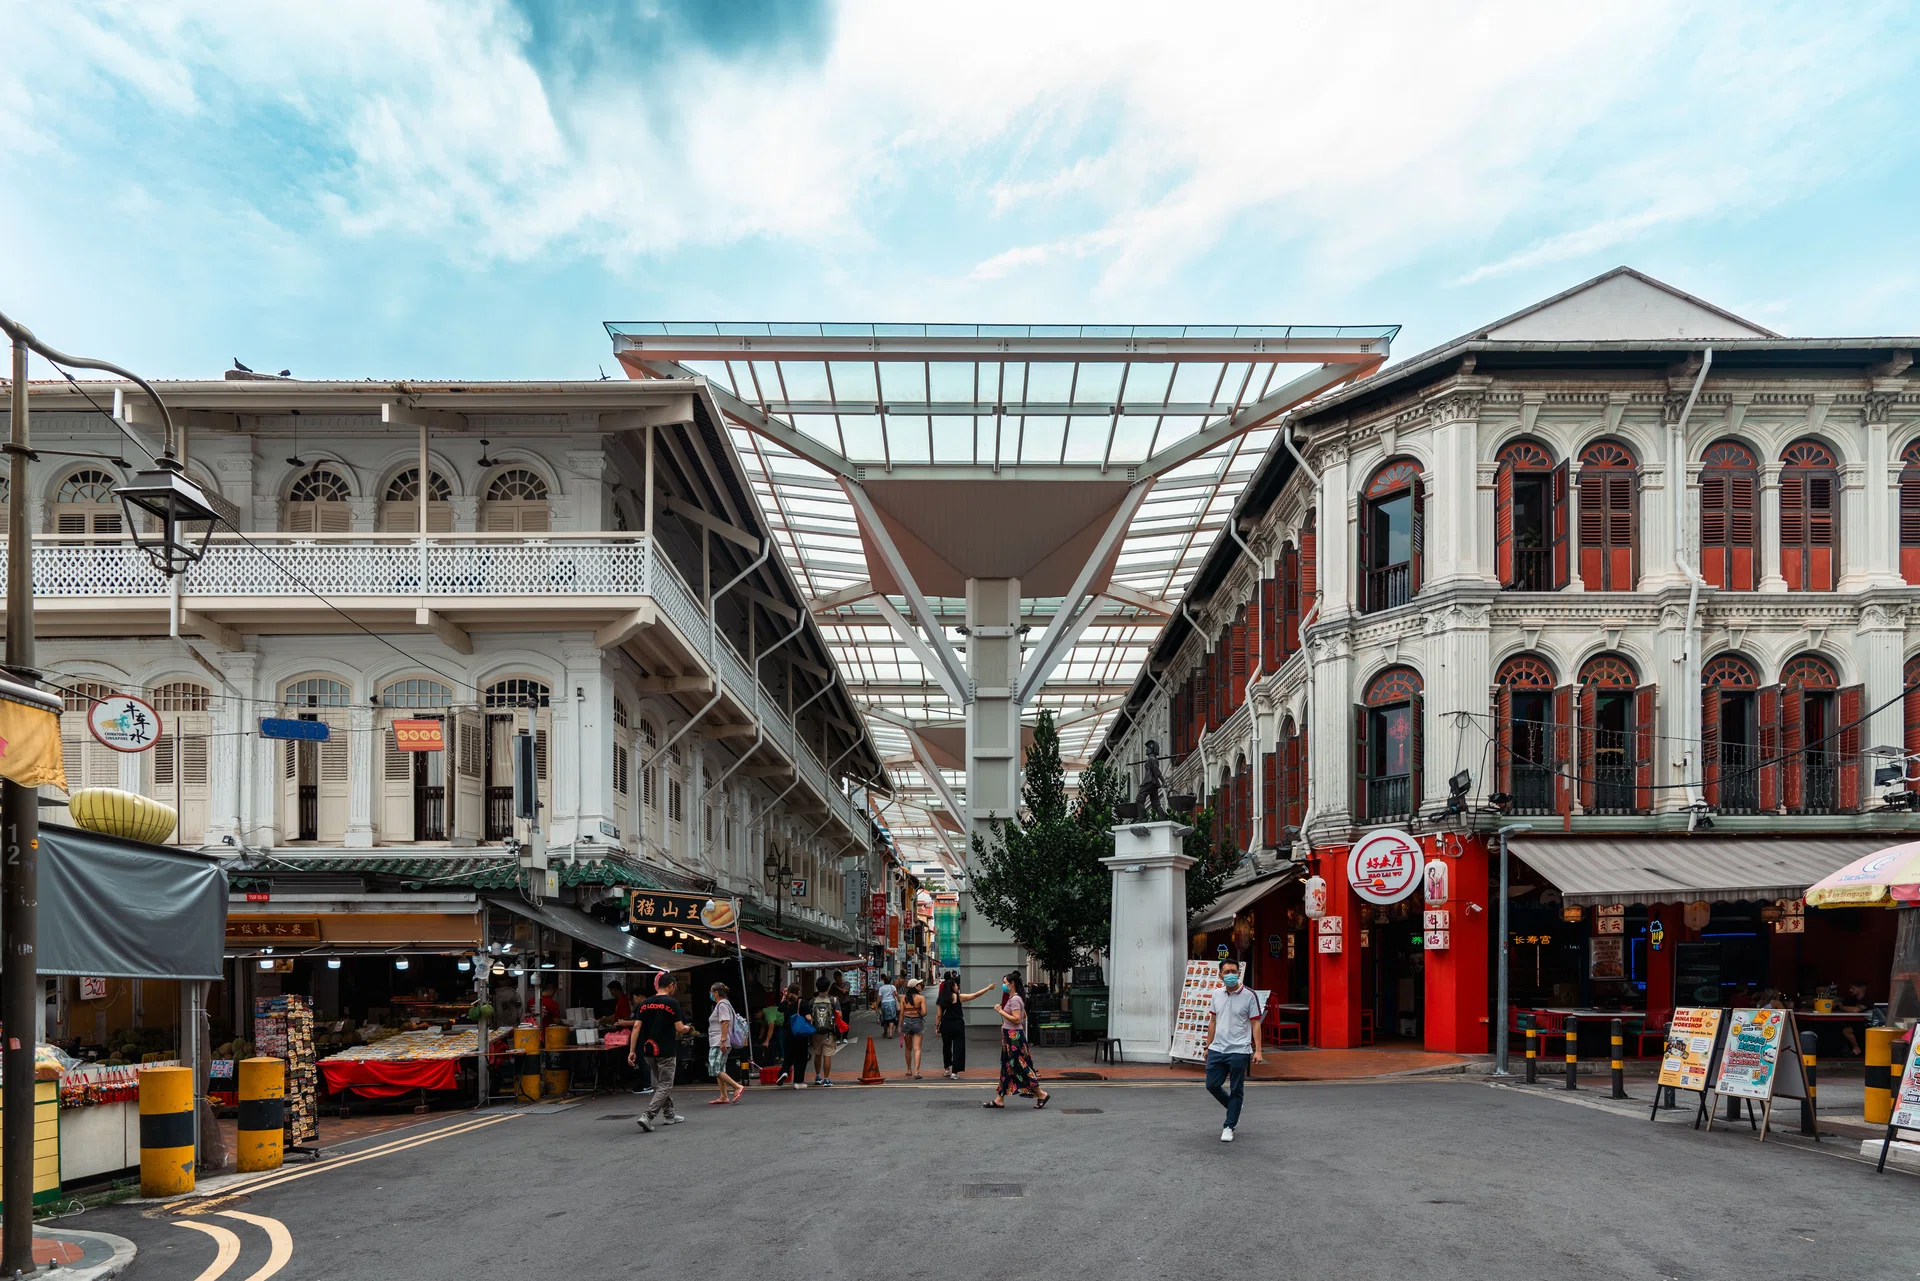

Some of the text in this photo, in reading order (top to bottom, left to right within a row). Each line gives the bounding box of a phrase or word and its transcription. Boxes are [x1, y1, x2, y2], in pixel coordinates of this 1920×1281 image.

[636, 899, 700, 920] 猫山王
[1322, 919, 1333, 950] 欢迎
[1513, 935, 1551, 945] 长寿宫
